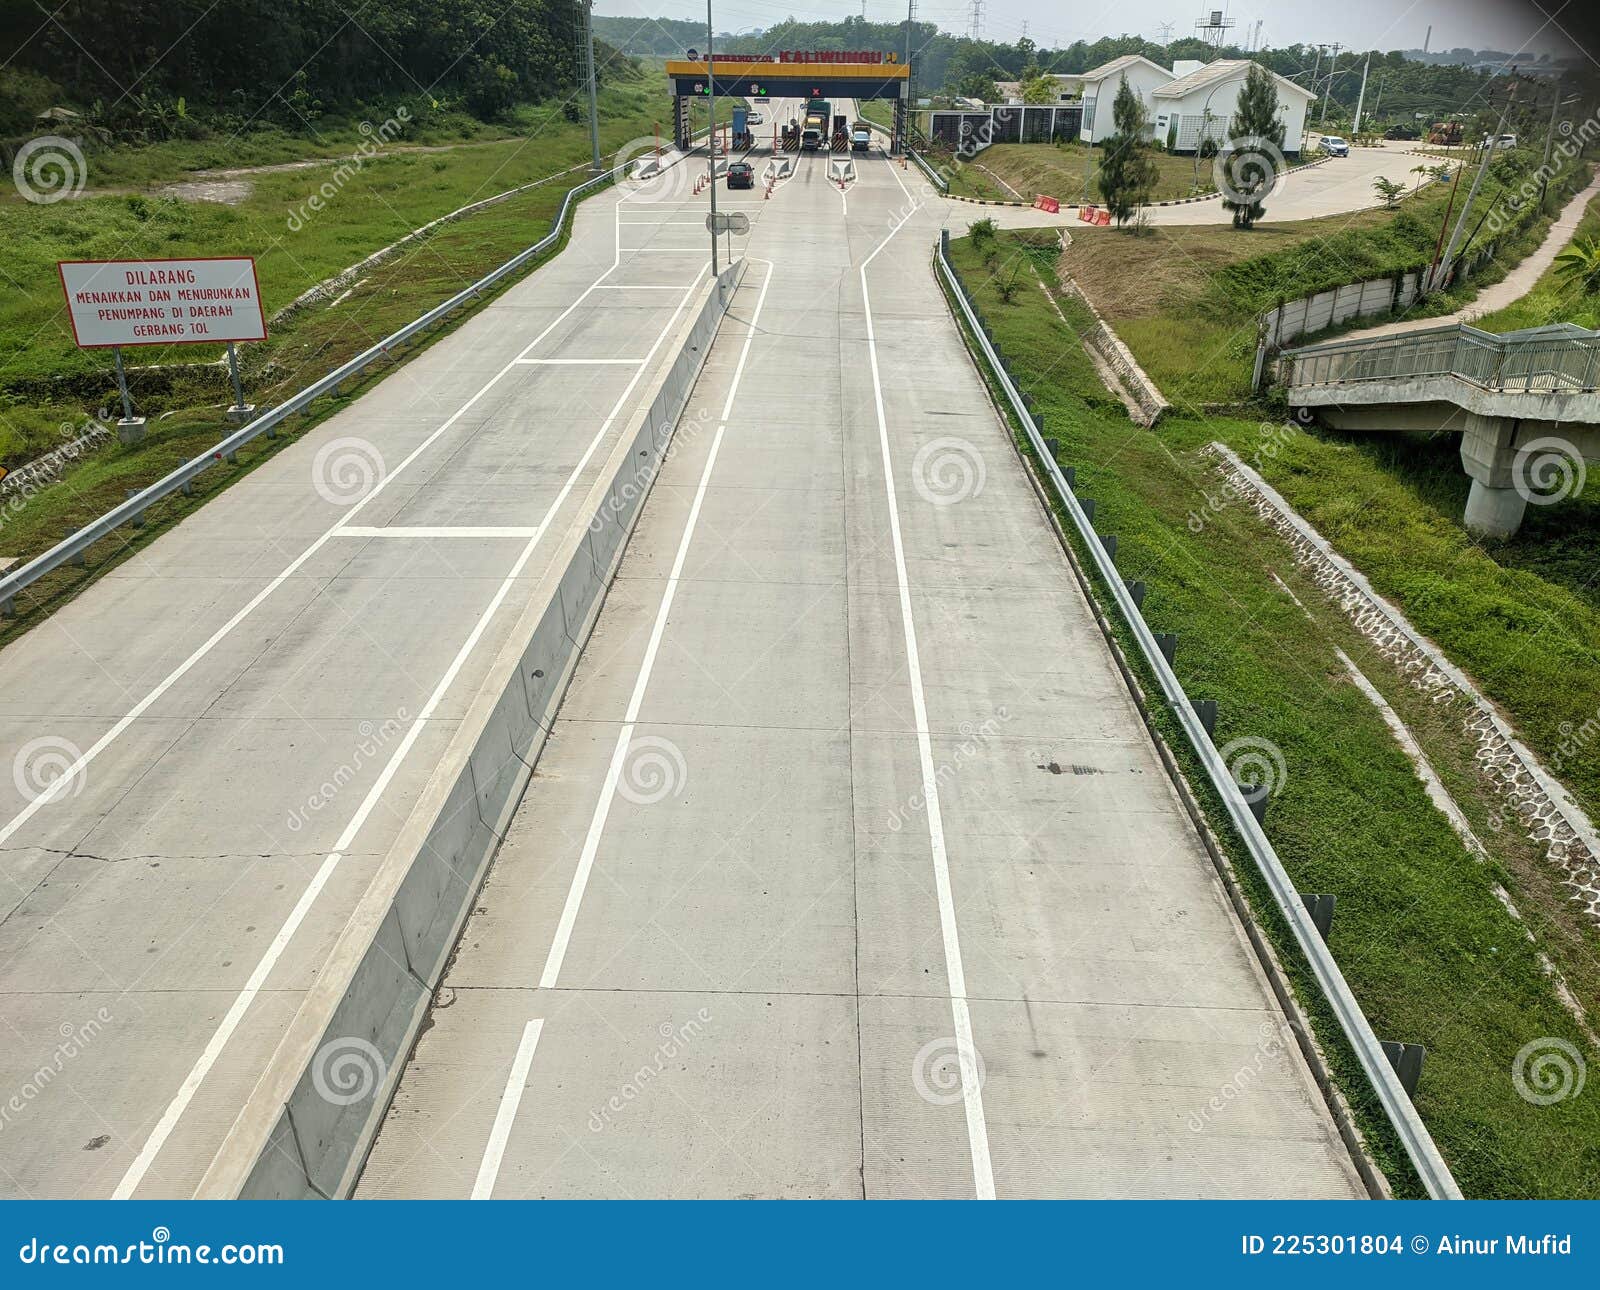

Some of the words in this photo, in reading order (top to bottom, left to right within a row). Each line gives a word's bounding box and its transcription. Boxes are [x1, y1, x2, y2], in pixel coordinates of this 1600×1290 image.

[779, 51, 882, 64] KALIWUNGU
[126, 270, 196, 285] DILARANG
[76, 290, 142, 304] MENAIKKAN
[149, 290, 171, 301] DAN
[178, 287, 250, 300] MENURUNKAN
[98, 307, 165, 320] PENUMPANG
[172, 307, 183, 318] DI
[190, 305, 233, 318] DAERAH
[133, 323, 185, 336] GERBANG
[191, 323, 209, 334] TOL
